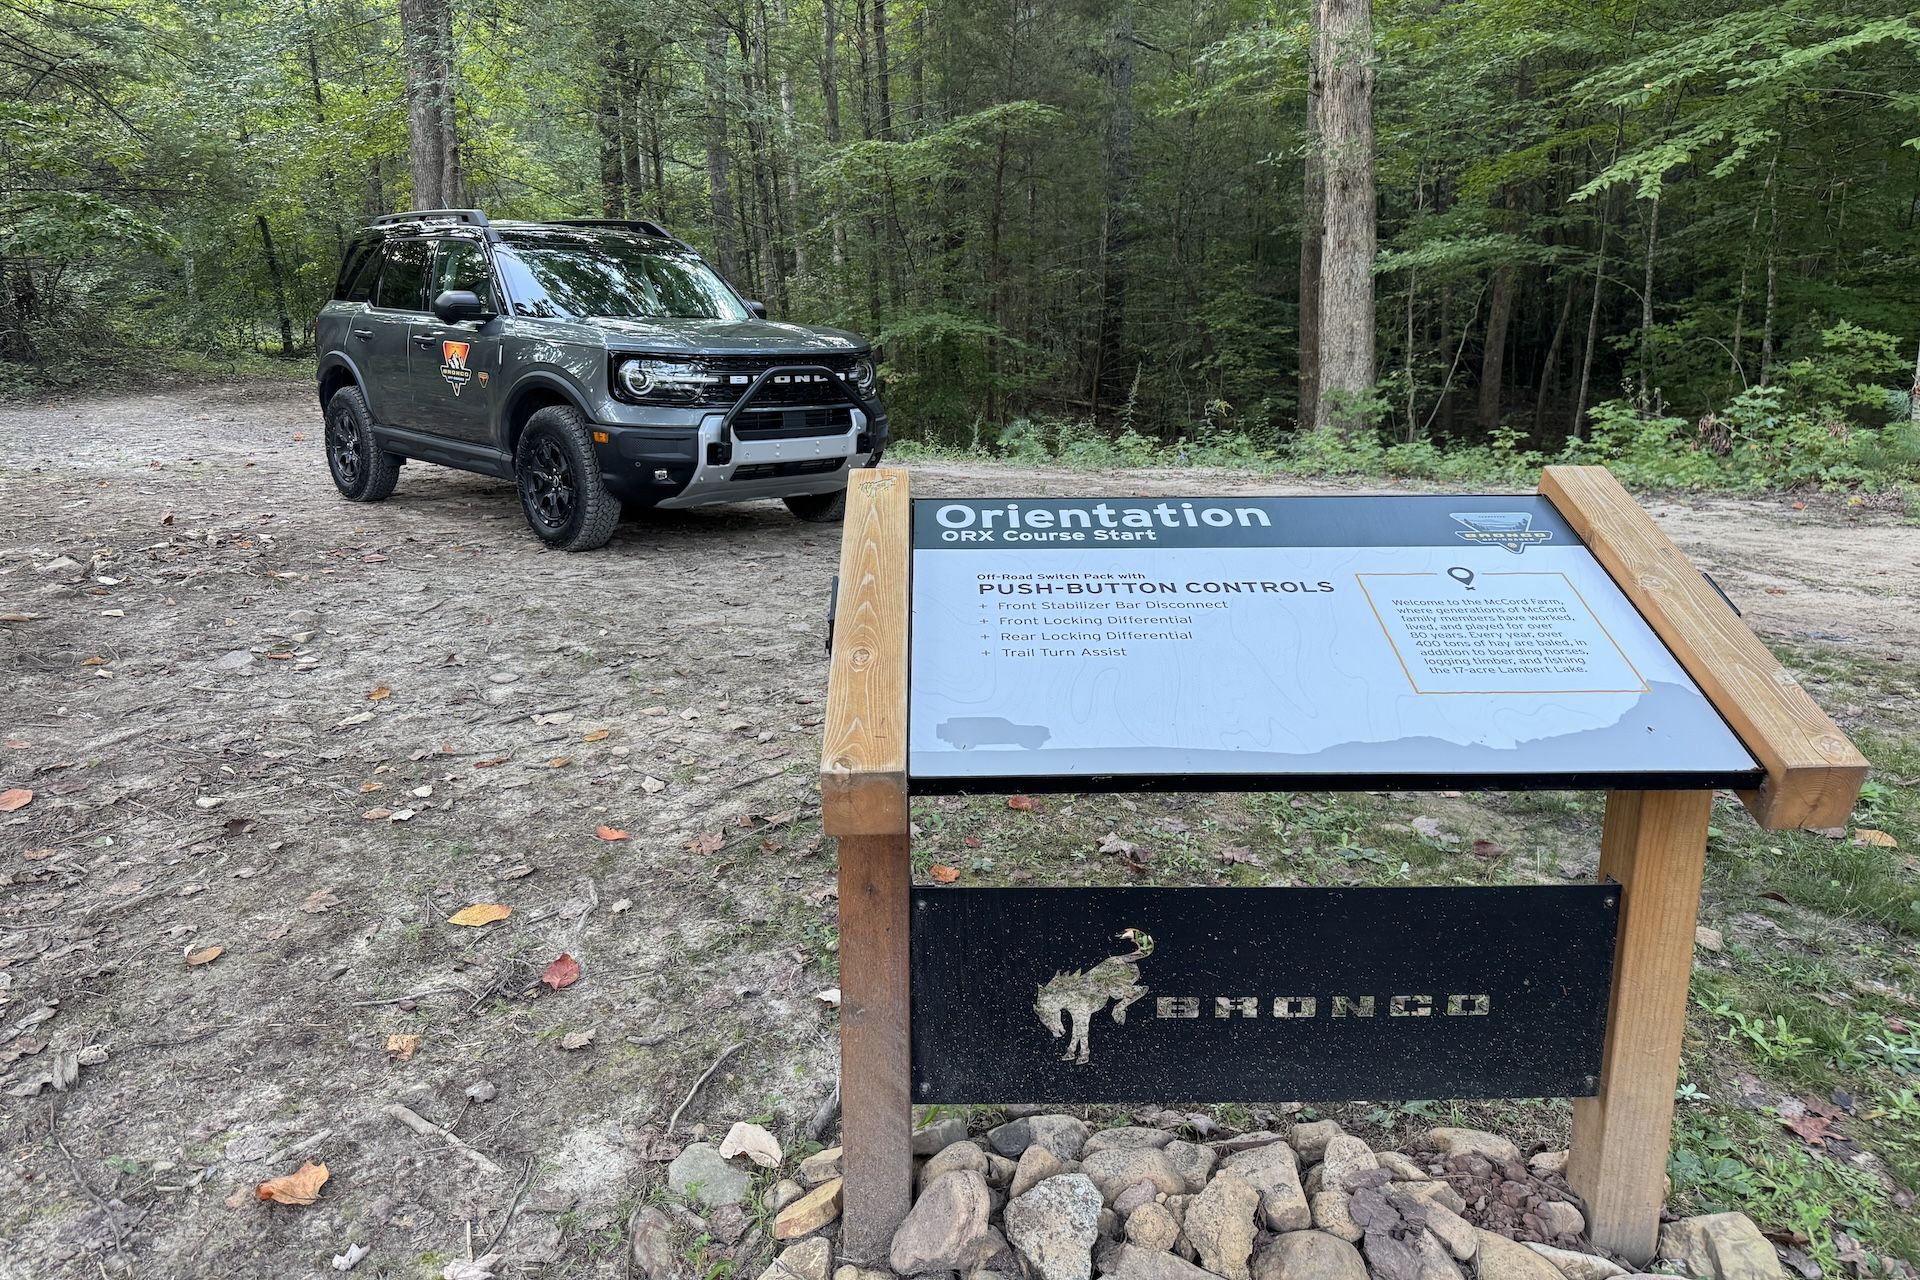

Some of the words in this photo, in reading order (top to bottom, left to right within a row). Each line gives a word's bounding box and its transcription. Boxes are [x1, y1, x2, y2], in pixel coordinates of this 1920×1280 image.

[936, 502, 1272, 528] Orientation
[942, 530, 994, 542] ORX
[1002, 530, 1086, 542] Course
[1094, 530, 1156, 541] Start
[979, 582, 1177, 594] PUSH-BUTTON
[1186, 582, 1335, 593] CONTROLS
[1041, 601, 1110, 610] Stabilizer
[1146, 601, 1228, 609] Disconnect
[1000, 617, 1038, 625] Front
[1044, 616, 1103, 626] Locking
[1108, 616, 1192, 624] Differential
[1001, 632, 1036, 641] Rear
[1042, 632, 1101, 642] Locking
[1106, 631, 1193, 640] Differential
[1002, 648, 1034, 657] Trail
[1040, 648, 1075, 657] Turn
[1081, 647, 1127, 656] Assist
[1156, 995, 1490, 1018] BRONCO
